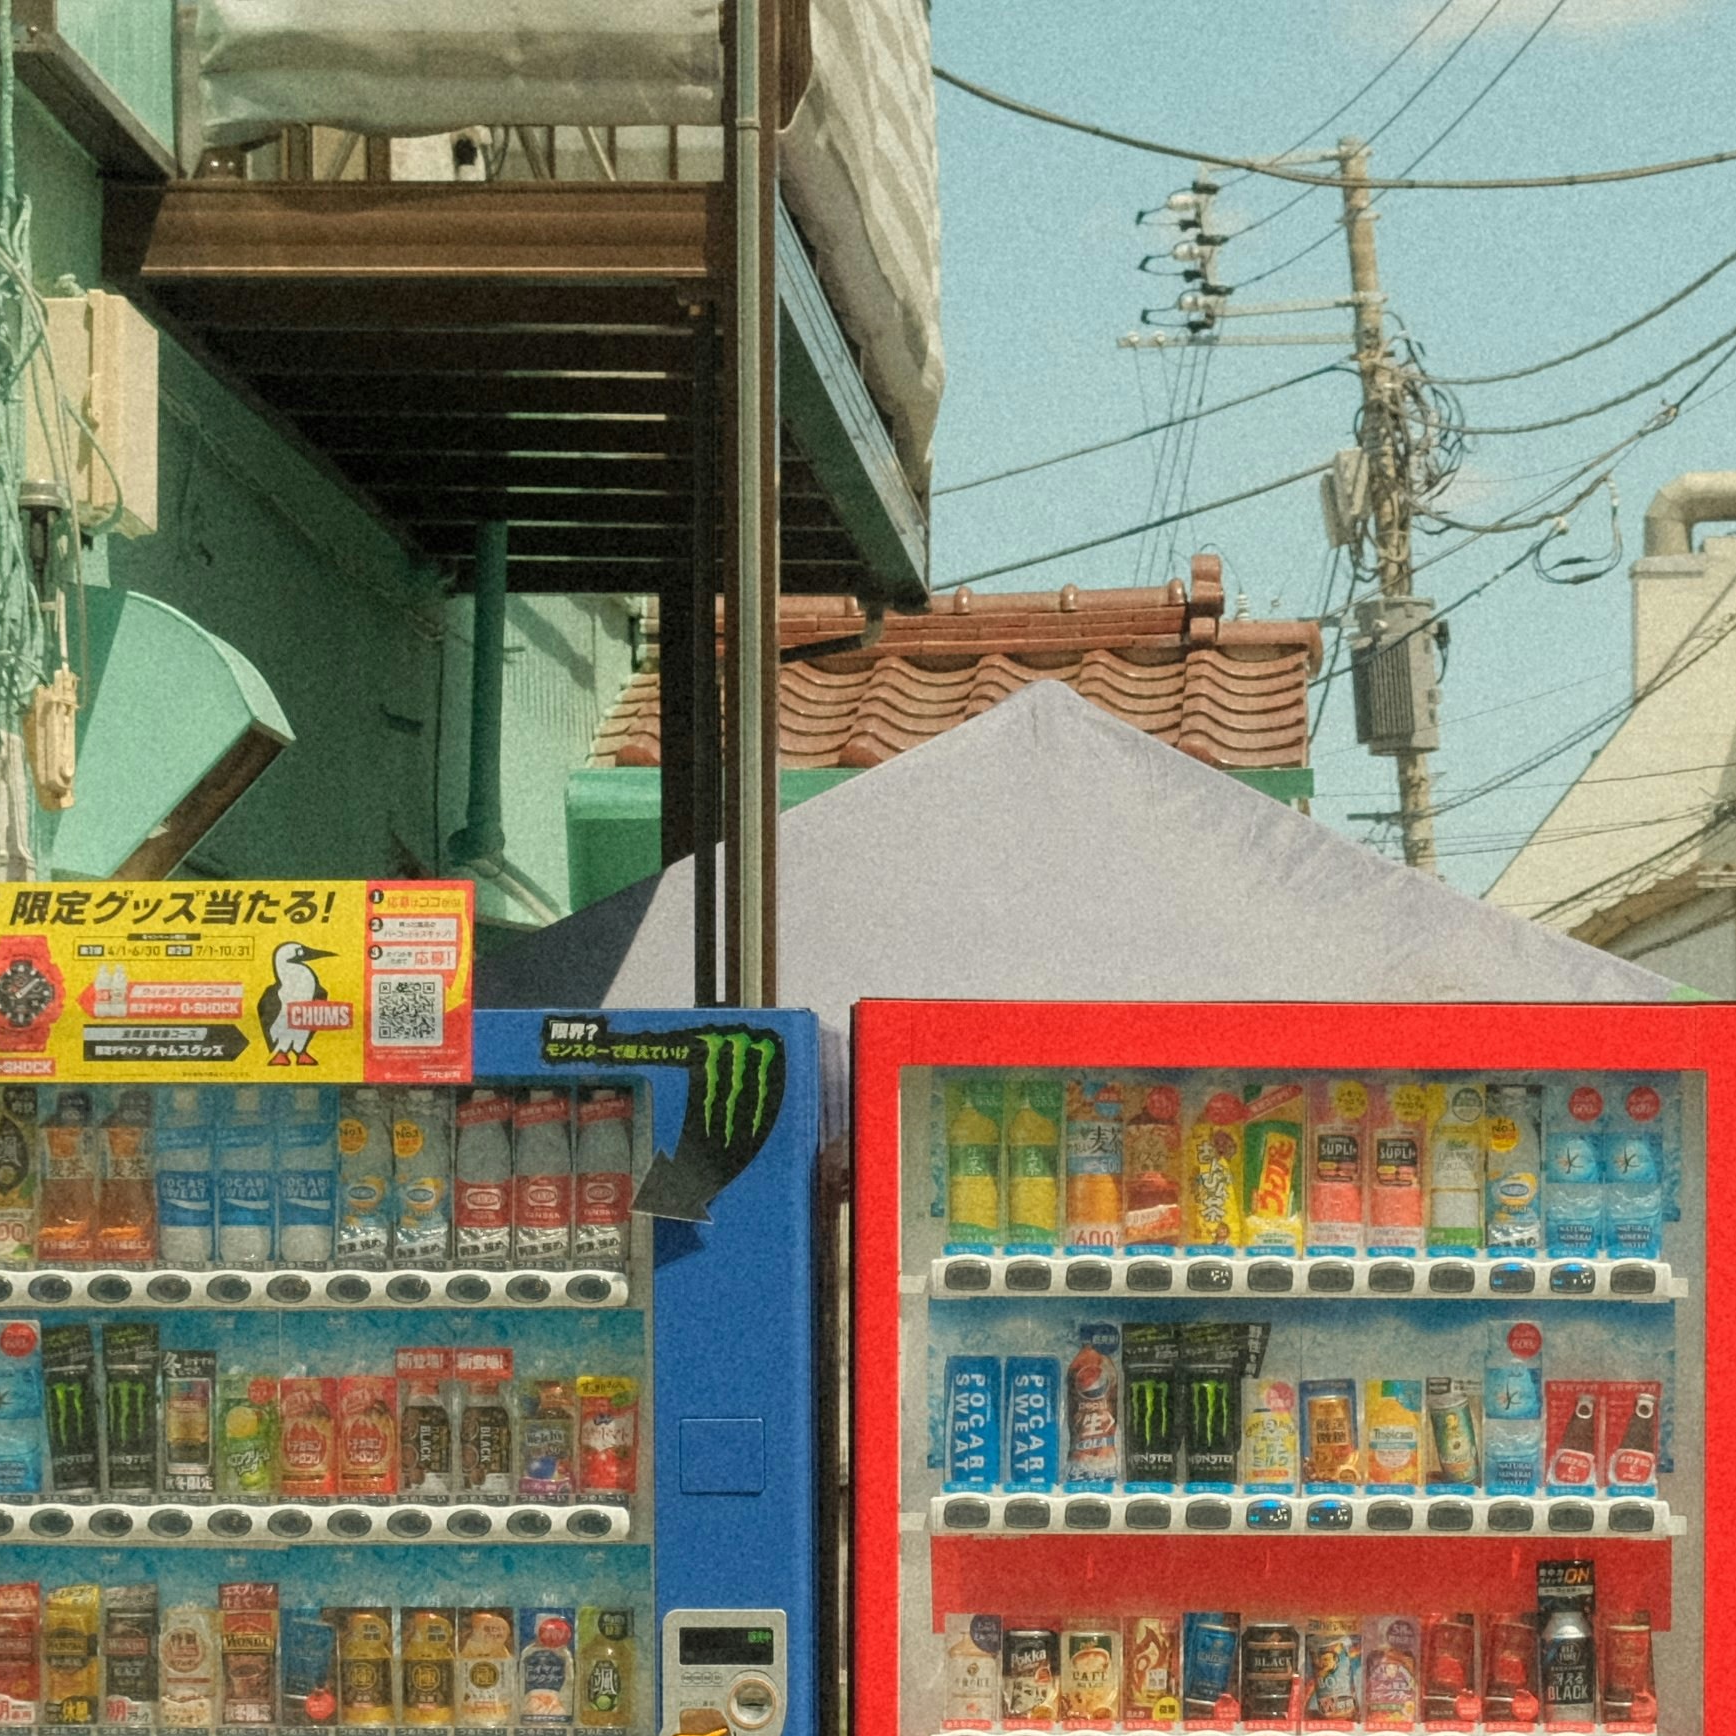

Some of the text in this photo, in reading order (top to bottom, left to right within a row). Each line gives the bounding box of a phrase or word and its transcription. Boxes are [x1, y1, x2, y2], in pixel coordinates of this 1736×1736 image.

[9, 889, 335, 926] 限定グッズ当たる!
[290, 1006, 351, 1027] CHUMS
[955, 1373, 970, 1471] SWEAT
[969, 1373, 985, 1483] POCARI
[1014, 1374, 1029, 1473] SWEAT
[1029, 1374, 1045, 1483] POCARI
[419, 1424, 431, 1463] BLACK
[479, 1425, 491, 1463] BLACK
[1076, 1438, 1108, 1450] COLA
[1564, 1567, 1591, 1584] ON
[224, 1636, 270, 1648] WONDA
[1010, 1649, 1048, 1667] Pokka
[1254, 1656, 1292, 1667] BLACK
[1548, 1686, 1589, 1701] BLACK
